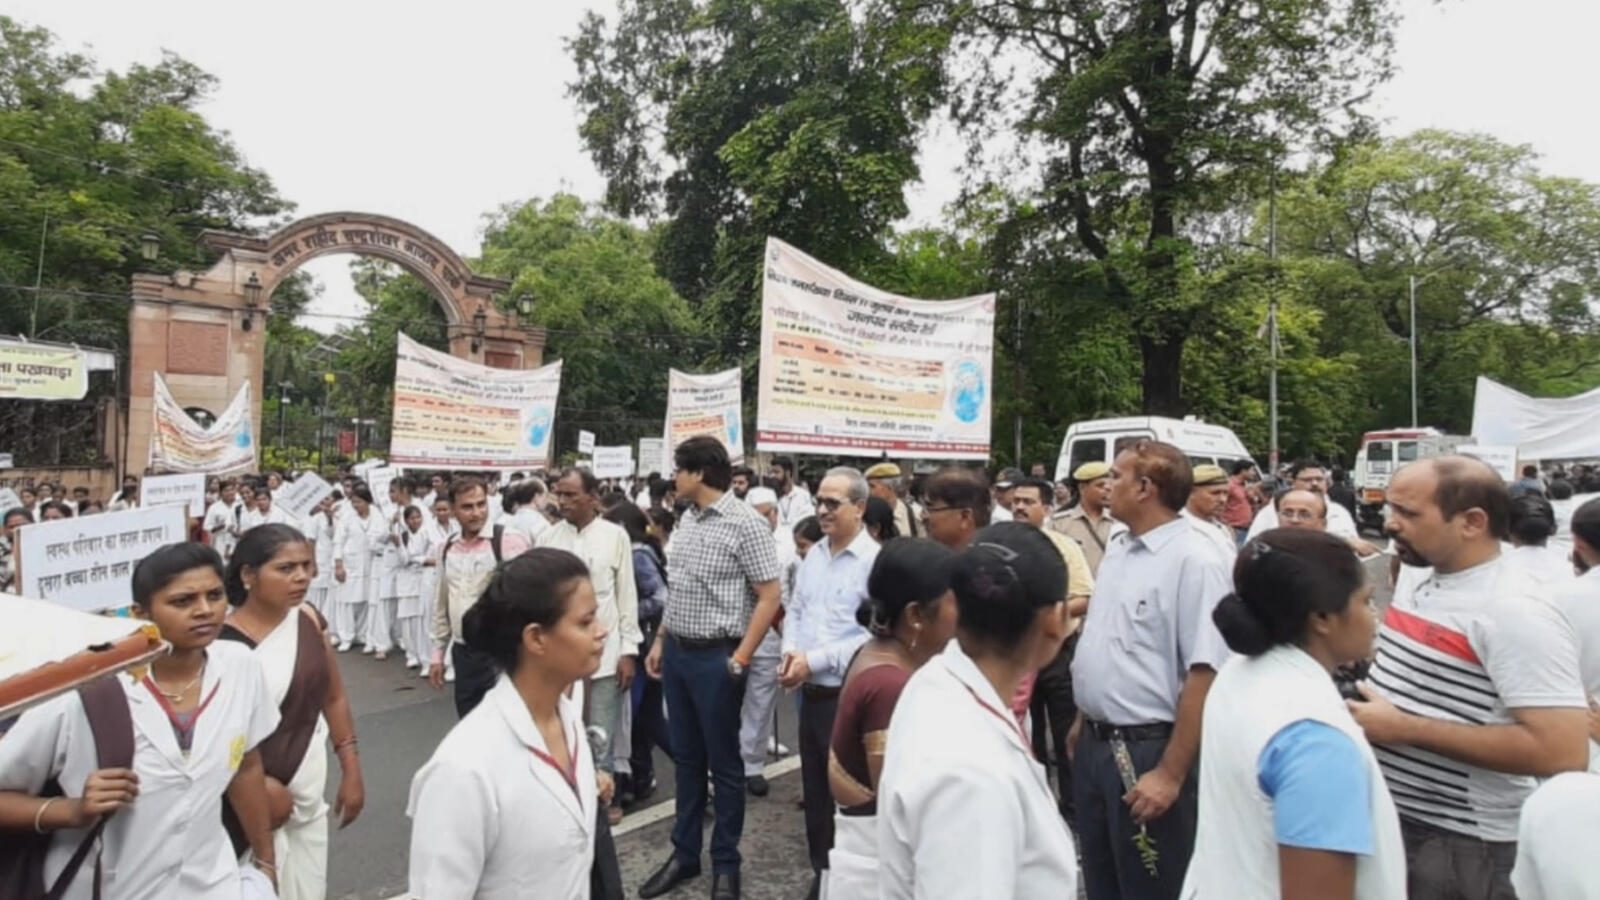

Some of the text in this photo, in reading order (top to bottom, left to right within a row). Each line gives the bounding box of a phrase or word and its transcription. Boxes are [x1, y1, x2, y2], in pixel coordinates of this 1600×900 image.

[16, 363, 72, 381] पखवाड़ा
[46, 542, 72, 562] स्वस्थ
[73, 532, 103, 557] परिवार
[105, 535, 117, 550] का
[38, 573, 62, 598] दूसरा
[64, 569, 88, 586] बच्चा
[90, 561, 108, 582] तीन
[110, 561, 130, 578] साल
